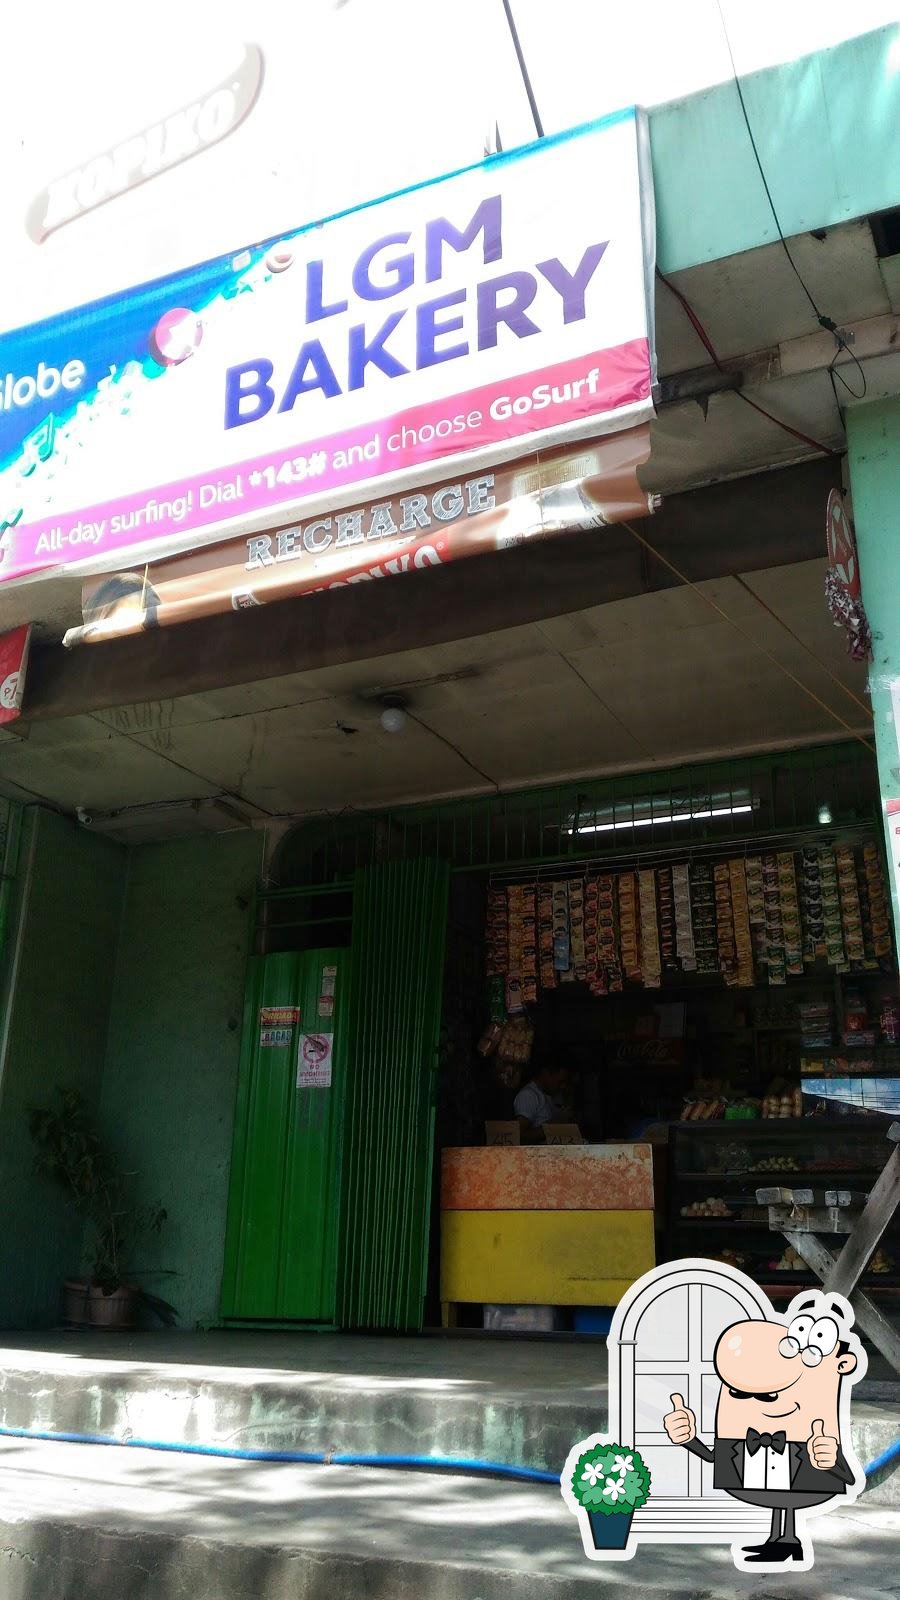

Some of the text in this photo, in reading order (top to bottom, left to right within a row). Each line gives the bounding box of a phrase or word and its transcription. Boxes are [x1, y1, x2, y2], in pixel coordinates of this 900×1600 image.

[305, 194, 503, 323] LGM
[0, 359, 86, 411] lobe
[224, 239, 610, 430] BAKERY
[34, 517, 106, 555] All-day
[111, 493, 194, 538] surfing!
[199, 475, 244, 508] Dial
[332, 434, 382, 471] and
[386, 409, 483, 454] choose
[488, 367, 601, 422] GoSurf
[244, 473, 497, 572] RECHARGE
